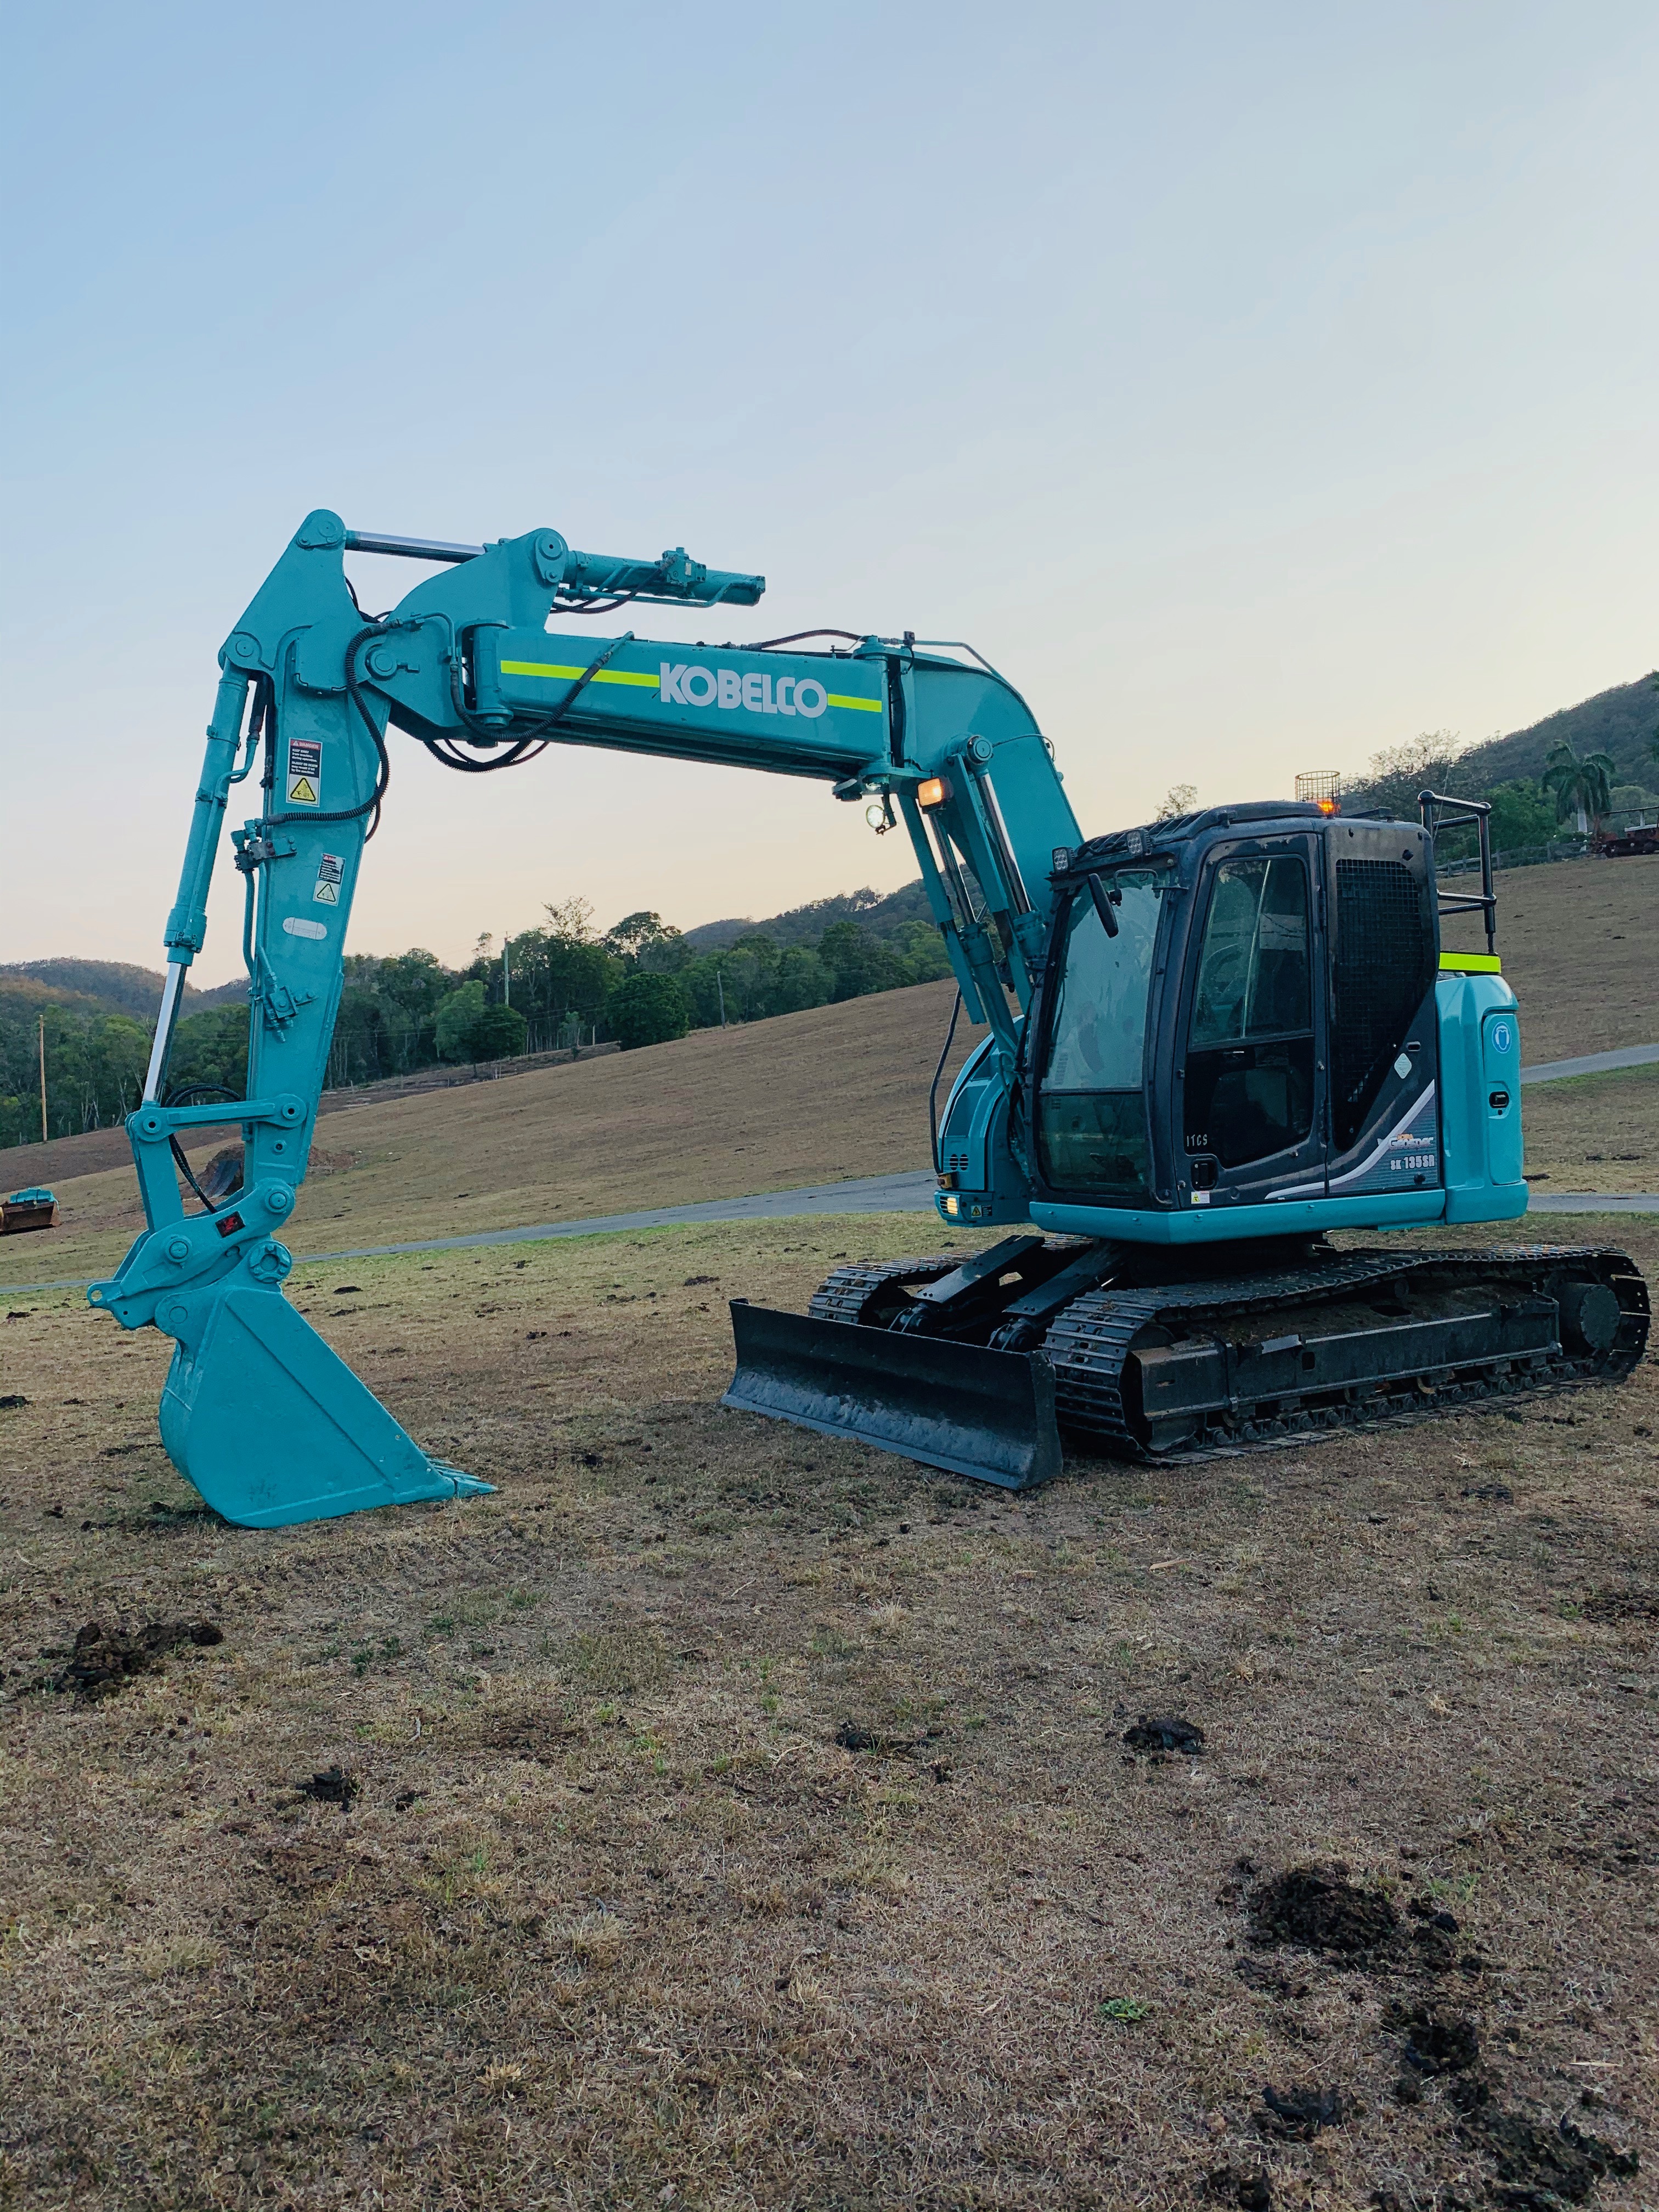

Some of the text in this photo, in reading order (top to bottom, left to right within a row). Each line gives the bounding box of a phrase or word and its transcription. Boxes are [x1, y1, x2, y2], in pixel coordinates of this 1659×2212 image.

[660, 662, 827, 718] KOBELCO
[1187, 1134, 1207, 1147] ITCS
[1403, 1154, 1435, 1169] 135SR
